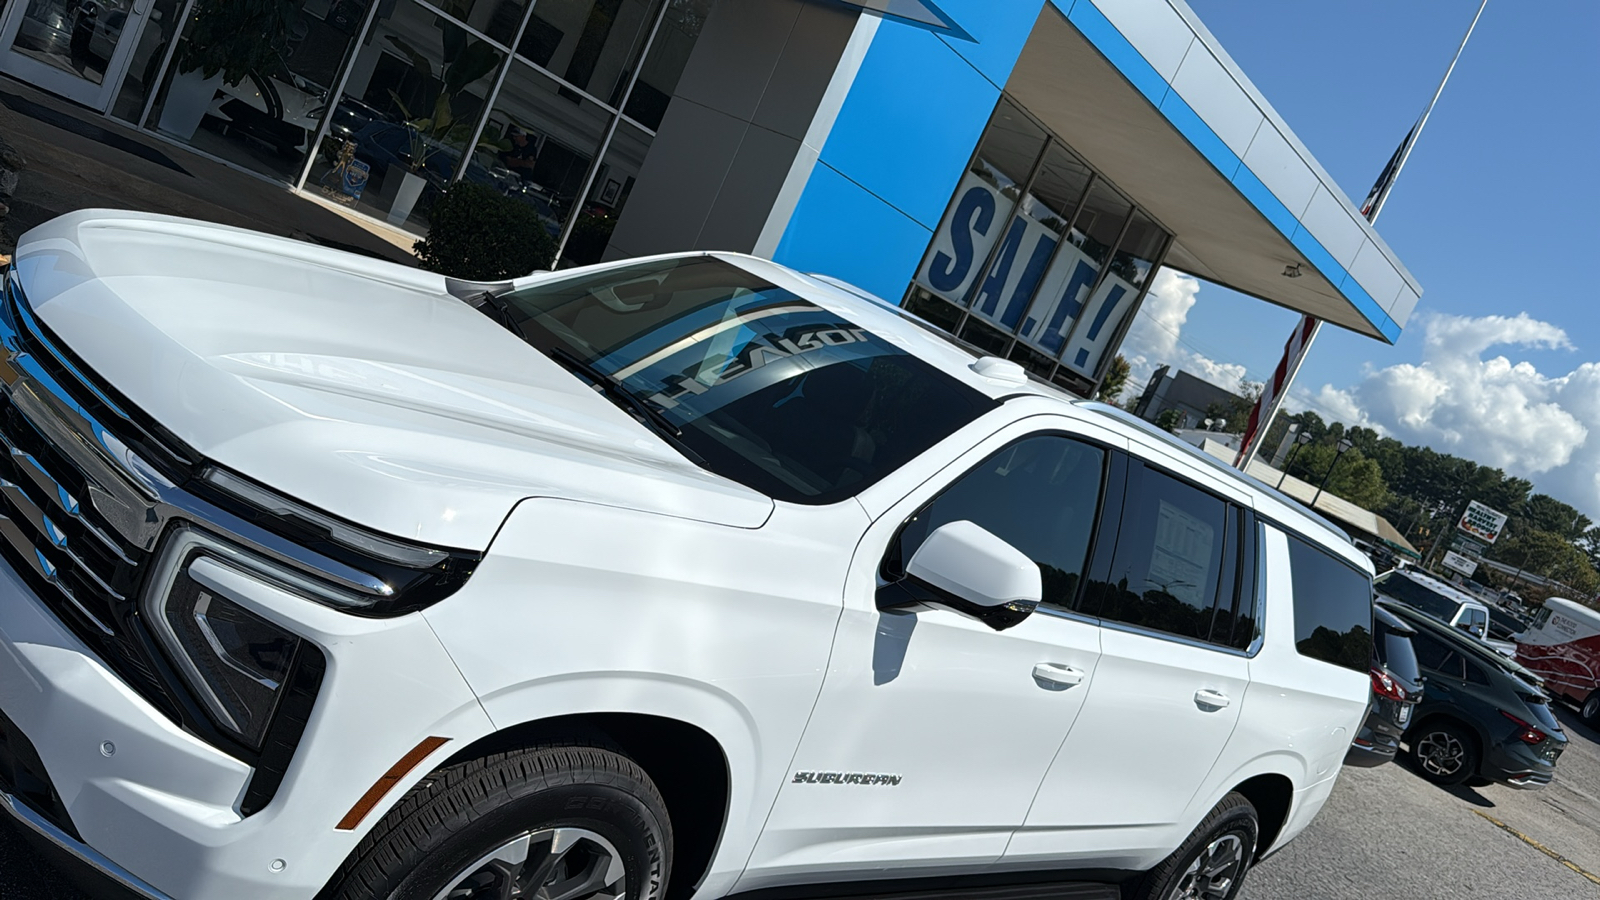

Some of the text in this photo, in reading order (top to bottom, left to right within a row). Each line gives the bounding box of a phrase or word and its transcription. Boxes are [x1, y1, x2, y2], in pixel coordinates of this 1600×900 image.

[928, 186, 1127, 368] SALE!
[1468, 506, 1497, 522] HEALTHY
[1468, 513, 1498, 529] HARVEST
[791, 771, 903, 786] SUBURBAN
[564, 795, 662, 900] CONTINENTA
